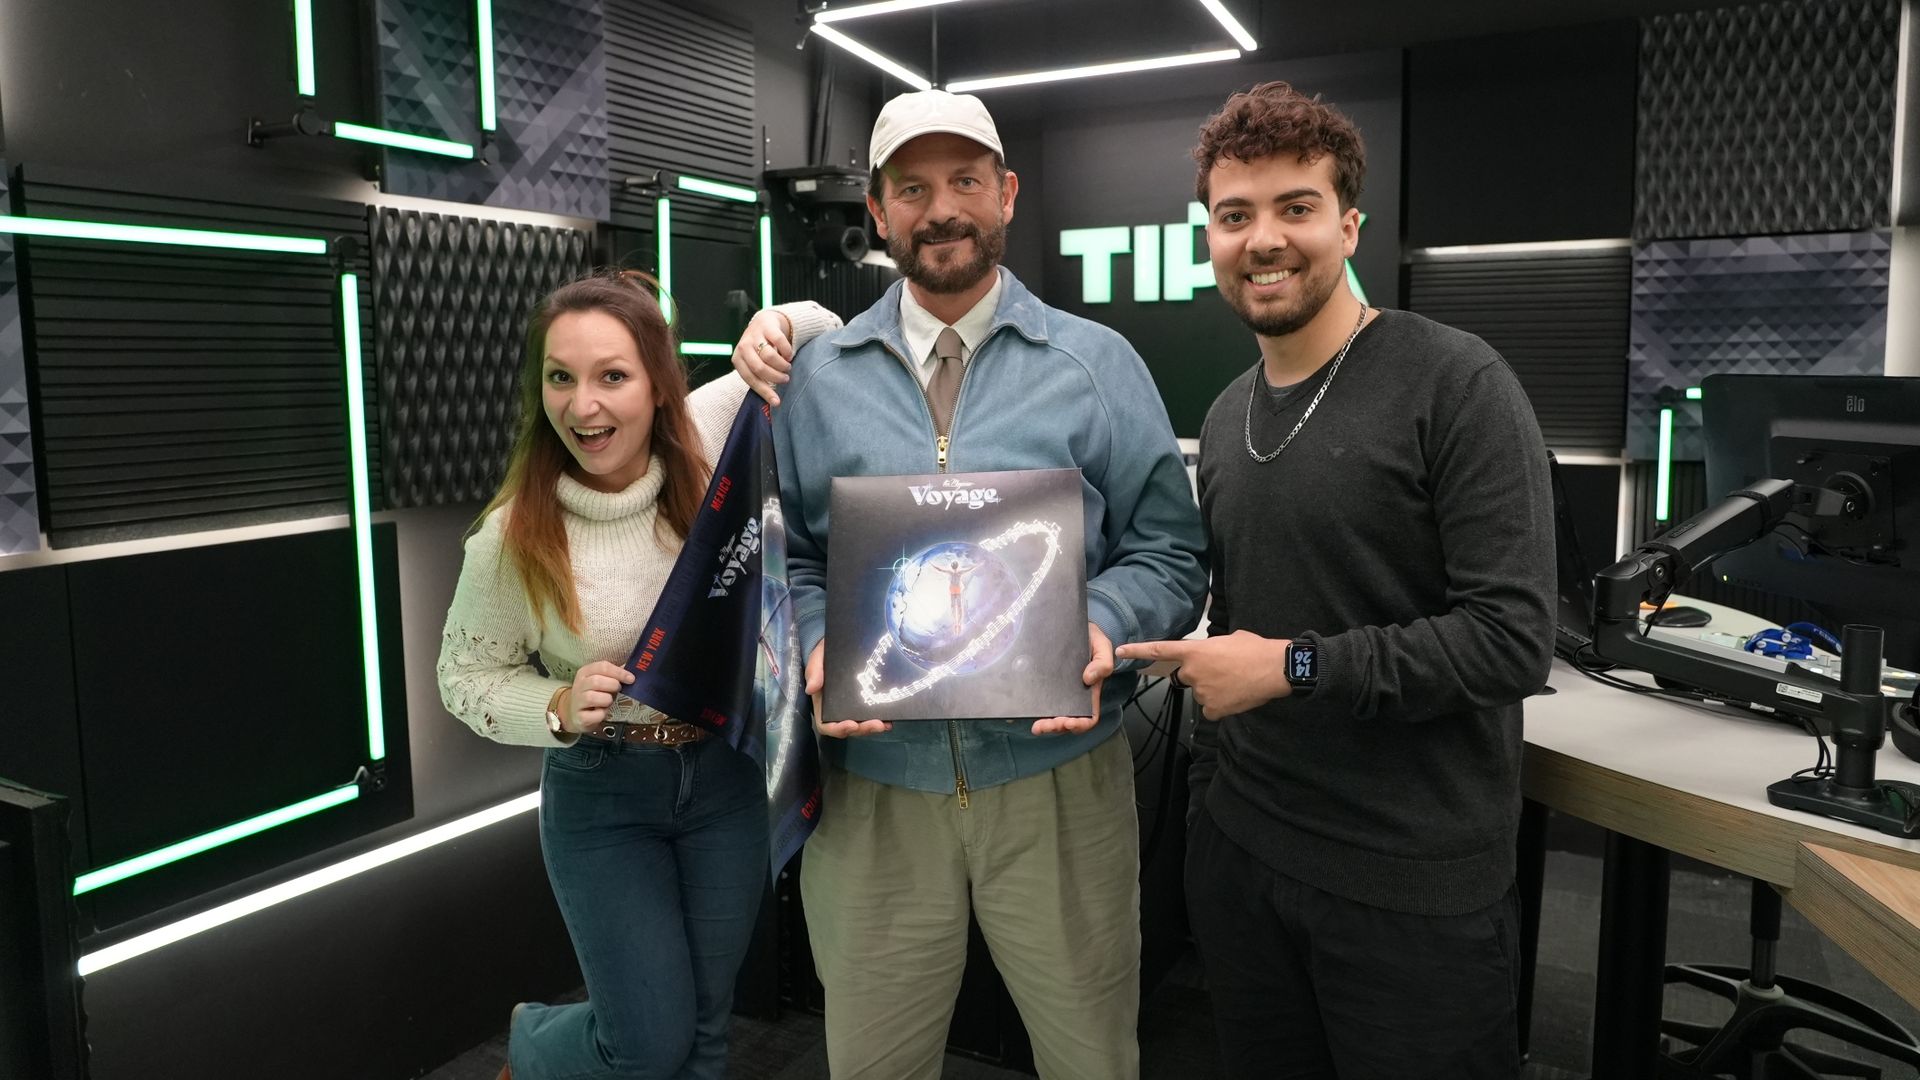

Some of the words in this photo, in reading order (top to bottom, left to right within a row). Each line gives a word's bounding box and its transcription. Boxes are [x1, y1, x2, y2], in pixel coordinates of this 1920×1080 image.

[1060, 202, 1368, 305] TIP
[711, 476, 733, 512] MEXICO
[908, 485, 999, 510] Voyage
[708, 517, 762, 599] Voyage
[635, 648, 654, 672] NEW
[650, 626, 666, 651] YORK
[1295, 651, 1313, 664] 26
[1295, 664, 1311, 677] 14
